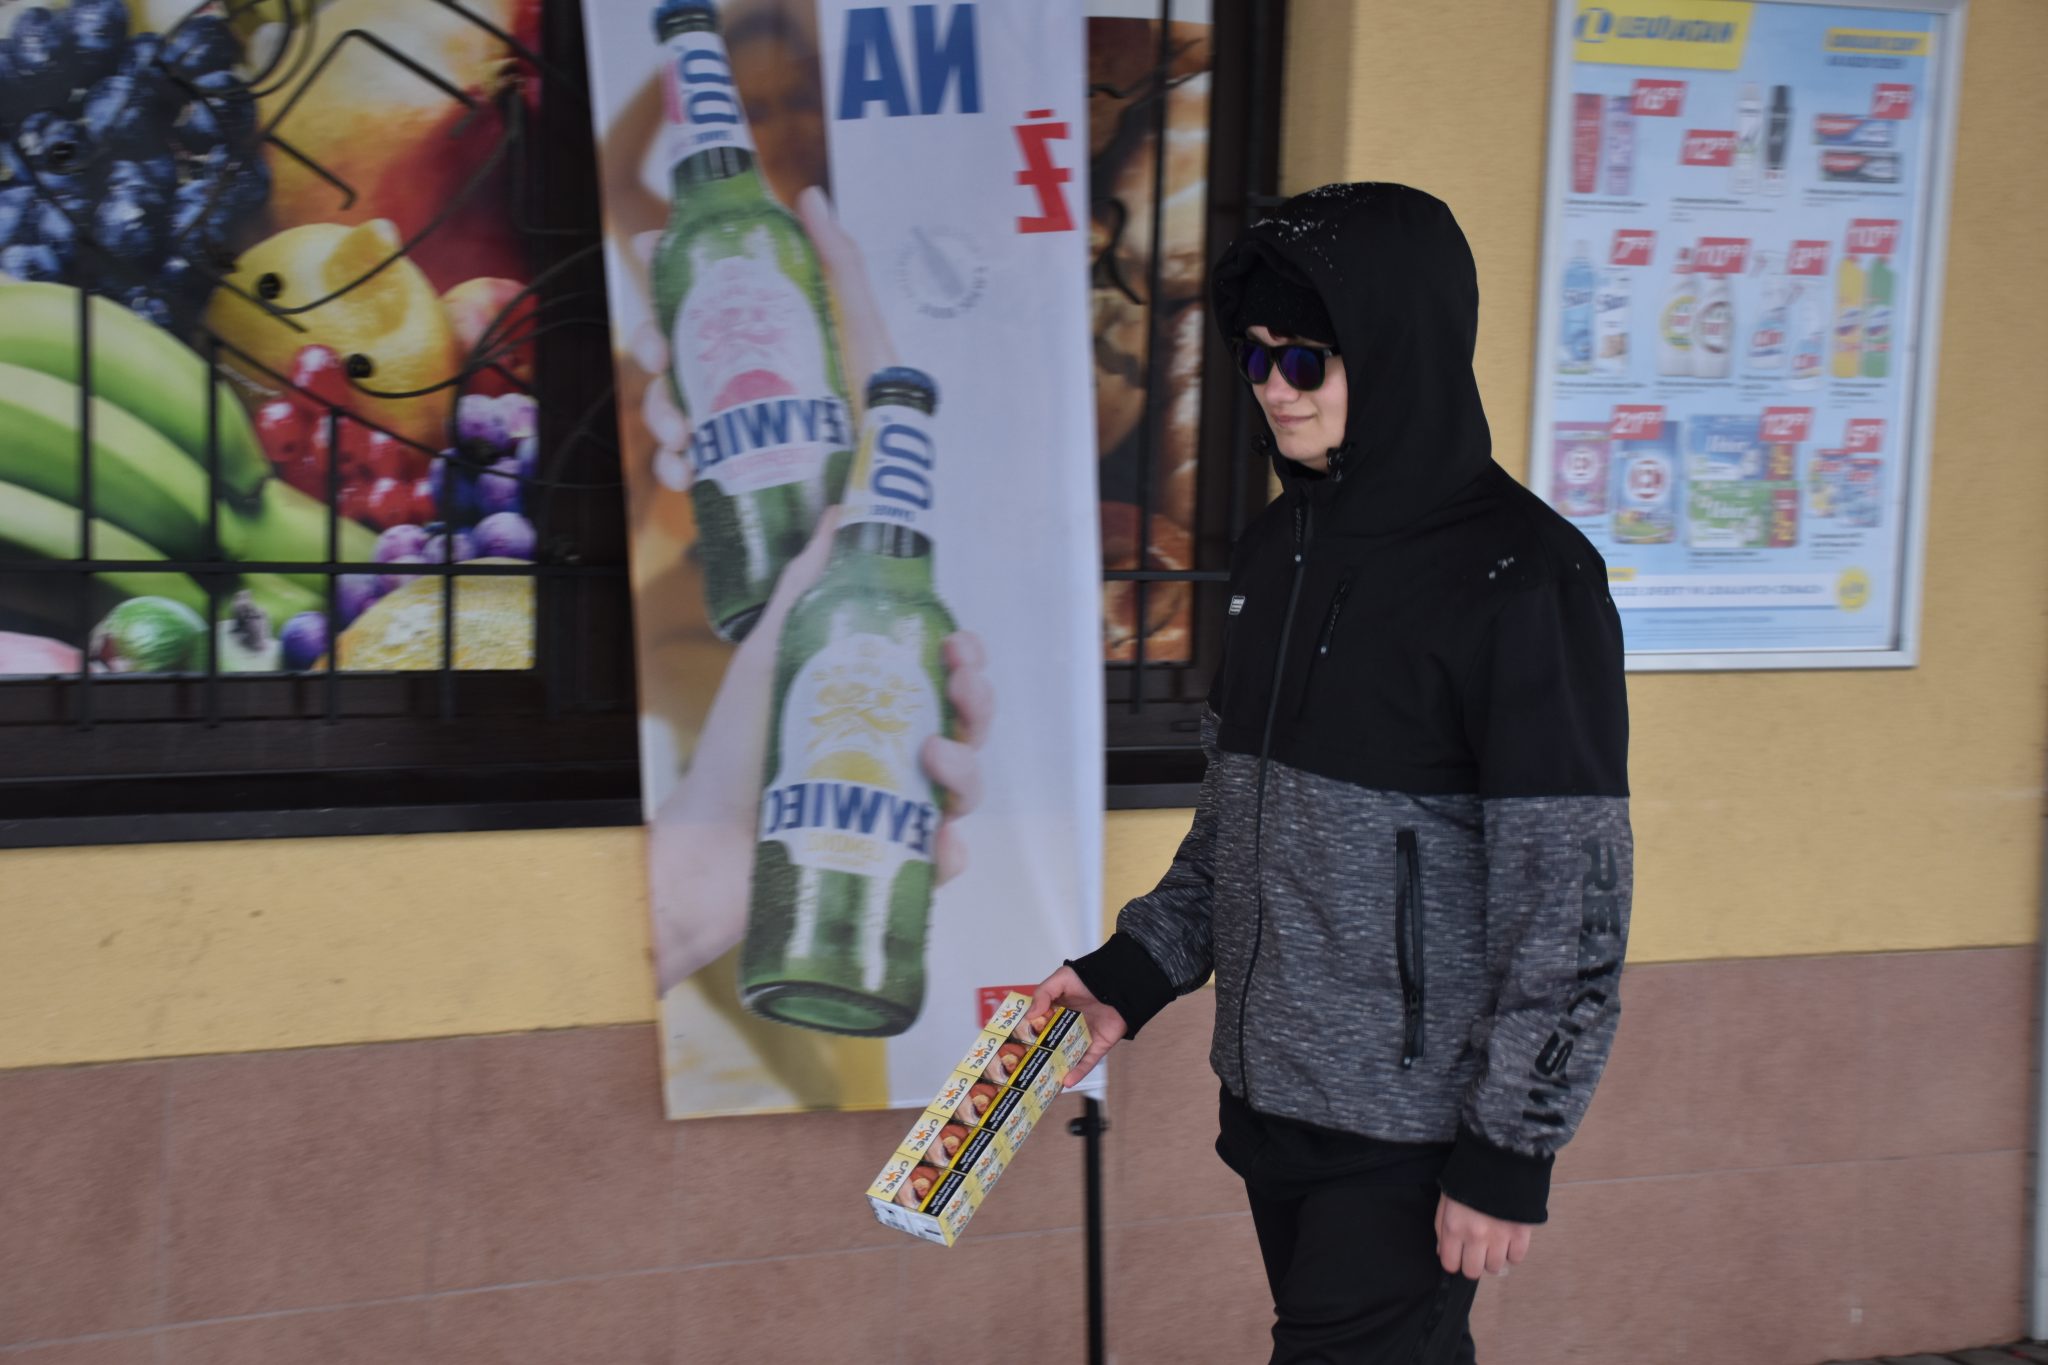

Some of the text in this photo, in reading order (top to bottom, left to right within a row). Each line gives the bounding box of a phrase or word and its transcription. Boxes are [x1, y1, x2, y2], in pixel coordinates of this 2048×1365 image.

[999, 998, 1025, 1030] CAMEL
[971, 1037, 997, 1069] CAMEL
[942, 1078, 968, 1110] CAMEL
[912, 1119, 939, 1152] CAMEL
[882, 1160, 909, 1193] CAMEL
